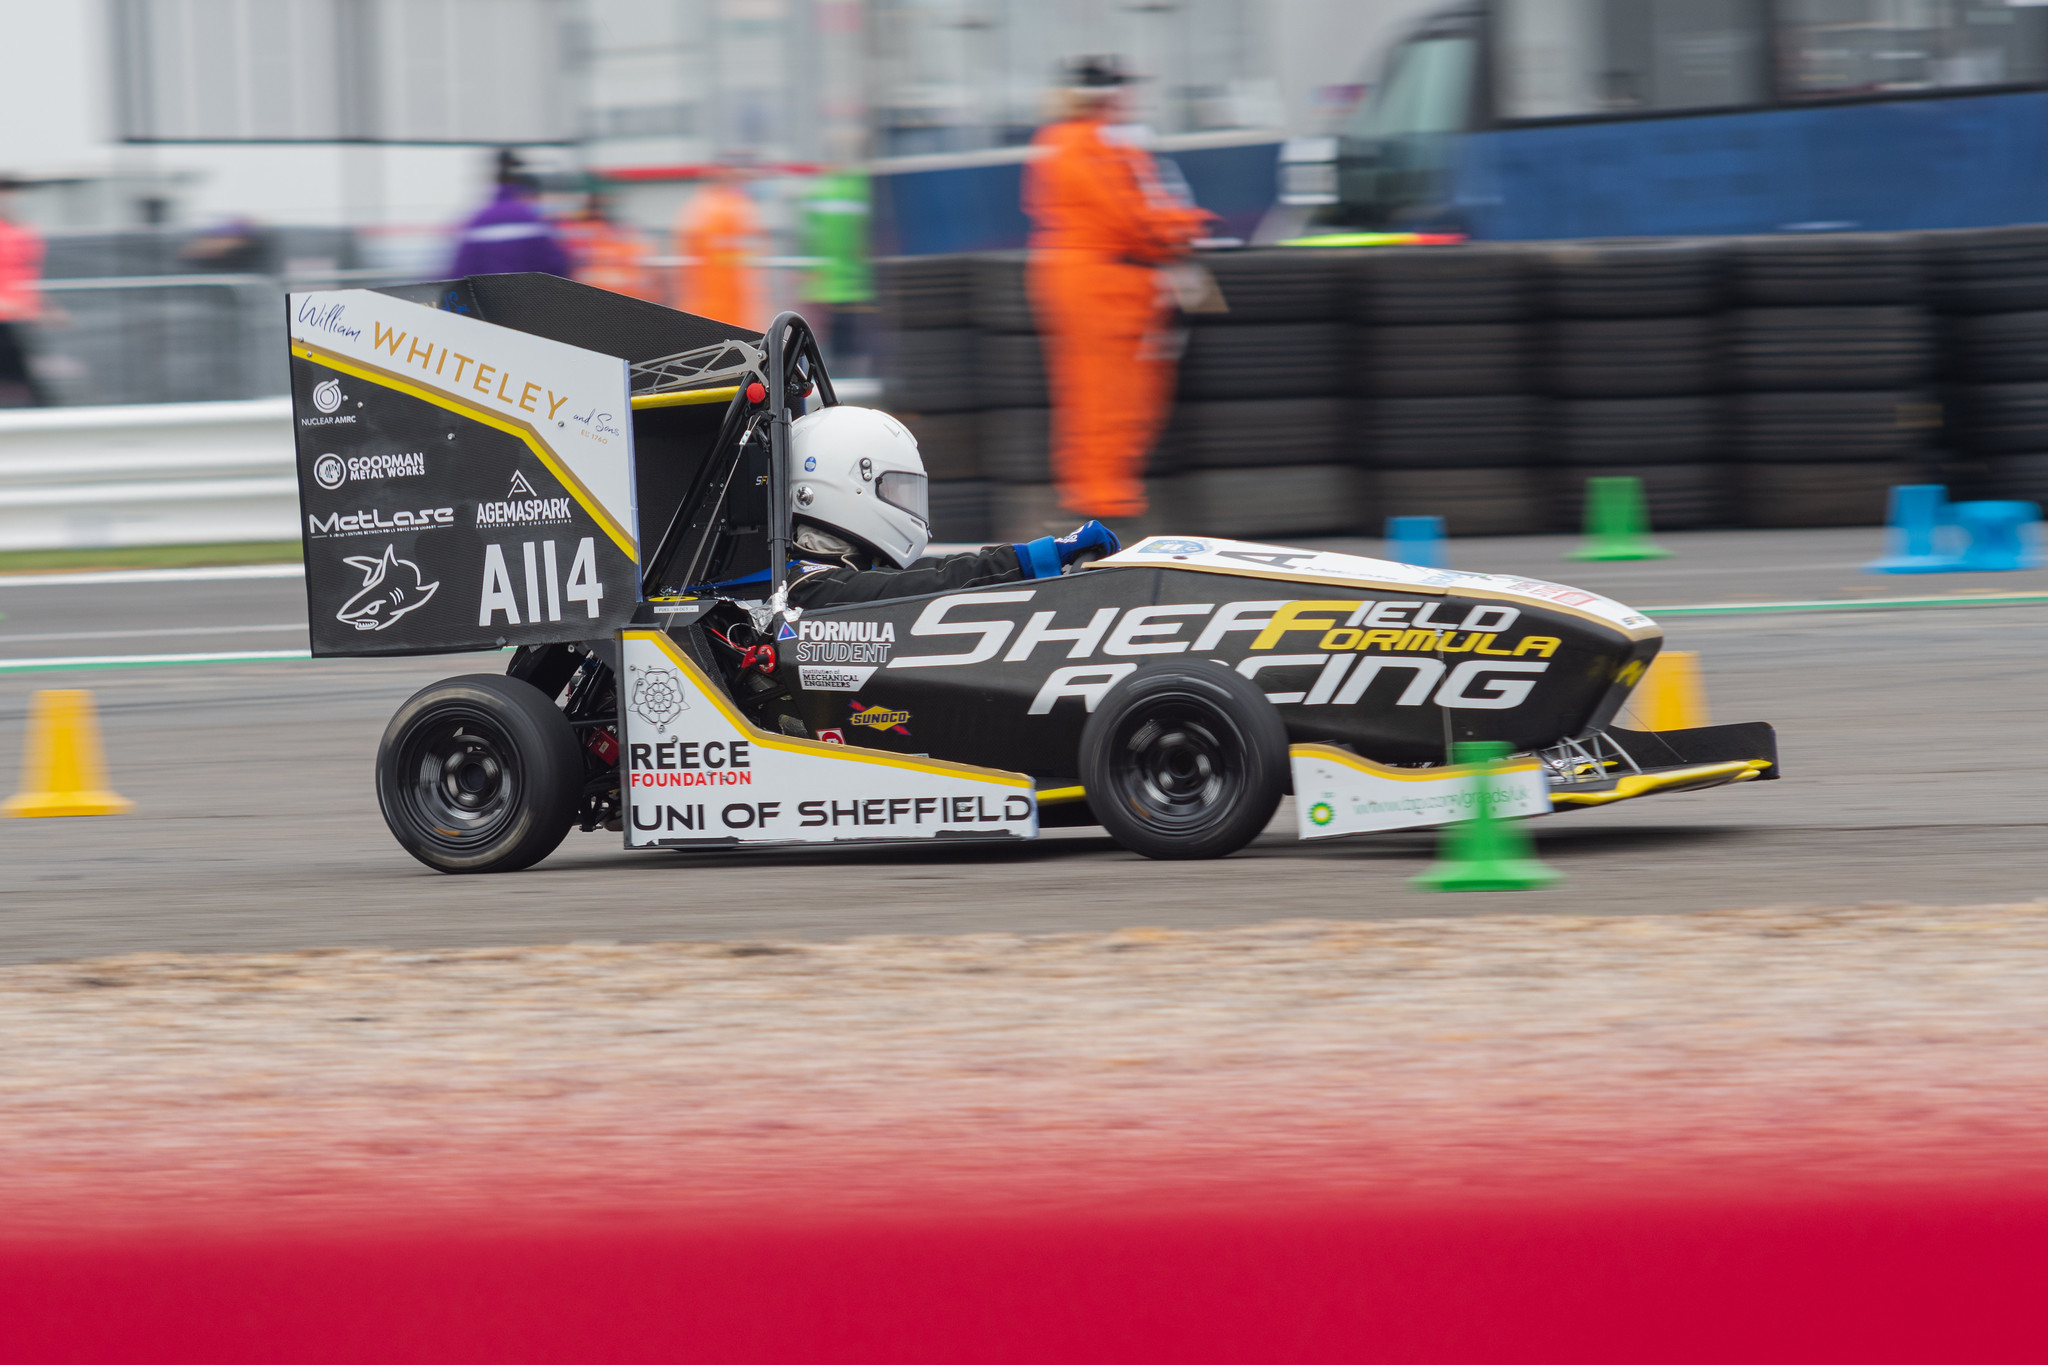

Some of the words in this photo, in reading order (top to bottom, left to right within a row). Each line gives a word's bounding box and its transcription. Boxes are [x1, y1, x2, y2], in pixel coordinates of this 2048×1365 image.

[298, 294, 362, 342] William
[373, 320, 569, 421] WHITELEY
[573, 408, 596, 426] and
[595, 413, 620, 437] Sons
[301, 417, 334, 427] NUCLEAR
[334, 415, 357, 425] AMRC
[347, 452, 424, 472] GOODMAN
[349, 469, 384, 481] METAL
[387, 465, 426, 478] WORKS
[476, 497, 571, 524] AGEMASPARK
[798, 620, 896, 643] FORMULA
[796, 641, 892, 663] STUDENT
[803, 674, 859, 682] MECHANICAL
[804, 680, 851, 688] ENGINEERS
[1027, 653, 1550, 716] RCING
[853, 710, 910, 725] SUNOCO
[630, 741, 751, 770] REECE
[631, 771, 752, 788] FOUNDATION
[632, 803, 705, 831] UNI
[721, 801, 781, 829] OF
[799, 795, 1033, 828] SHEFFIELD
